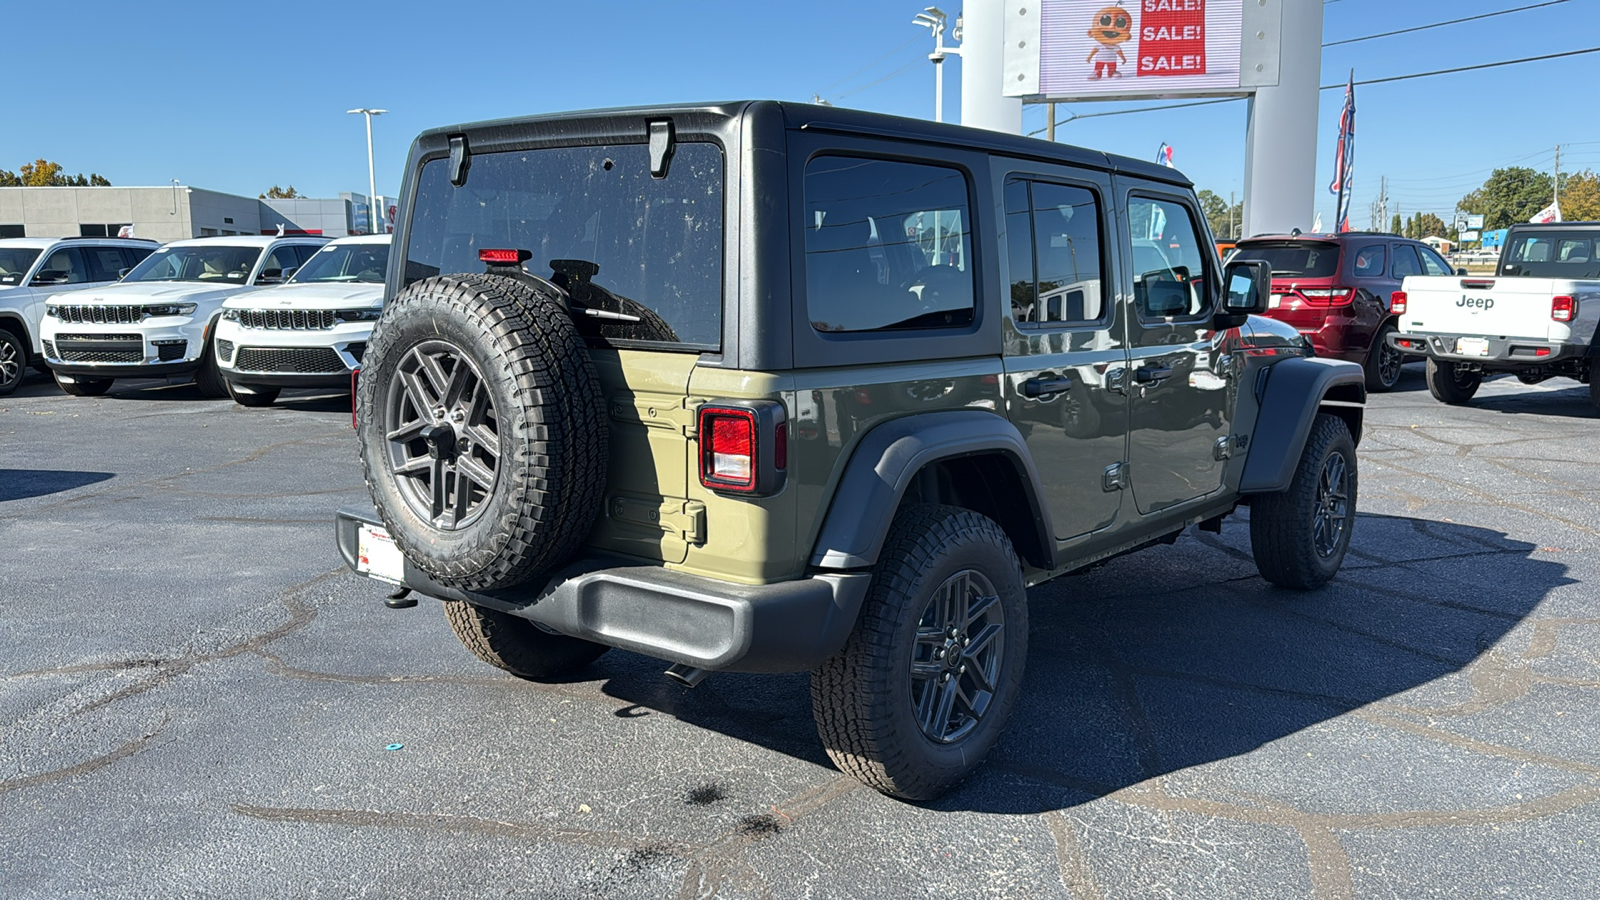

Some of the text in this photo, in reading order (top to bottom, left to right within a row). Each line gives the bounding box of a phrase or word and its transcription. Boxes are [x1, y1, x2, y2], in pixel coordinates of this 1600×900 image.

[1144, 0, 1201, 12] SALE!
[1143, 26, 1201, 41] SALE!
[1140, 54, 1201, 71] SALE!
[1456, 294, 1495, 311] Jeep
